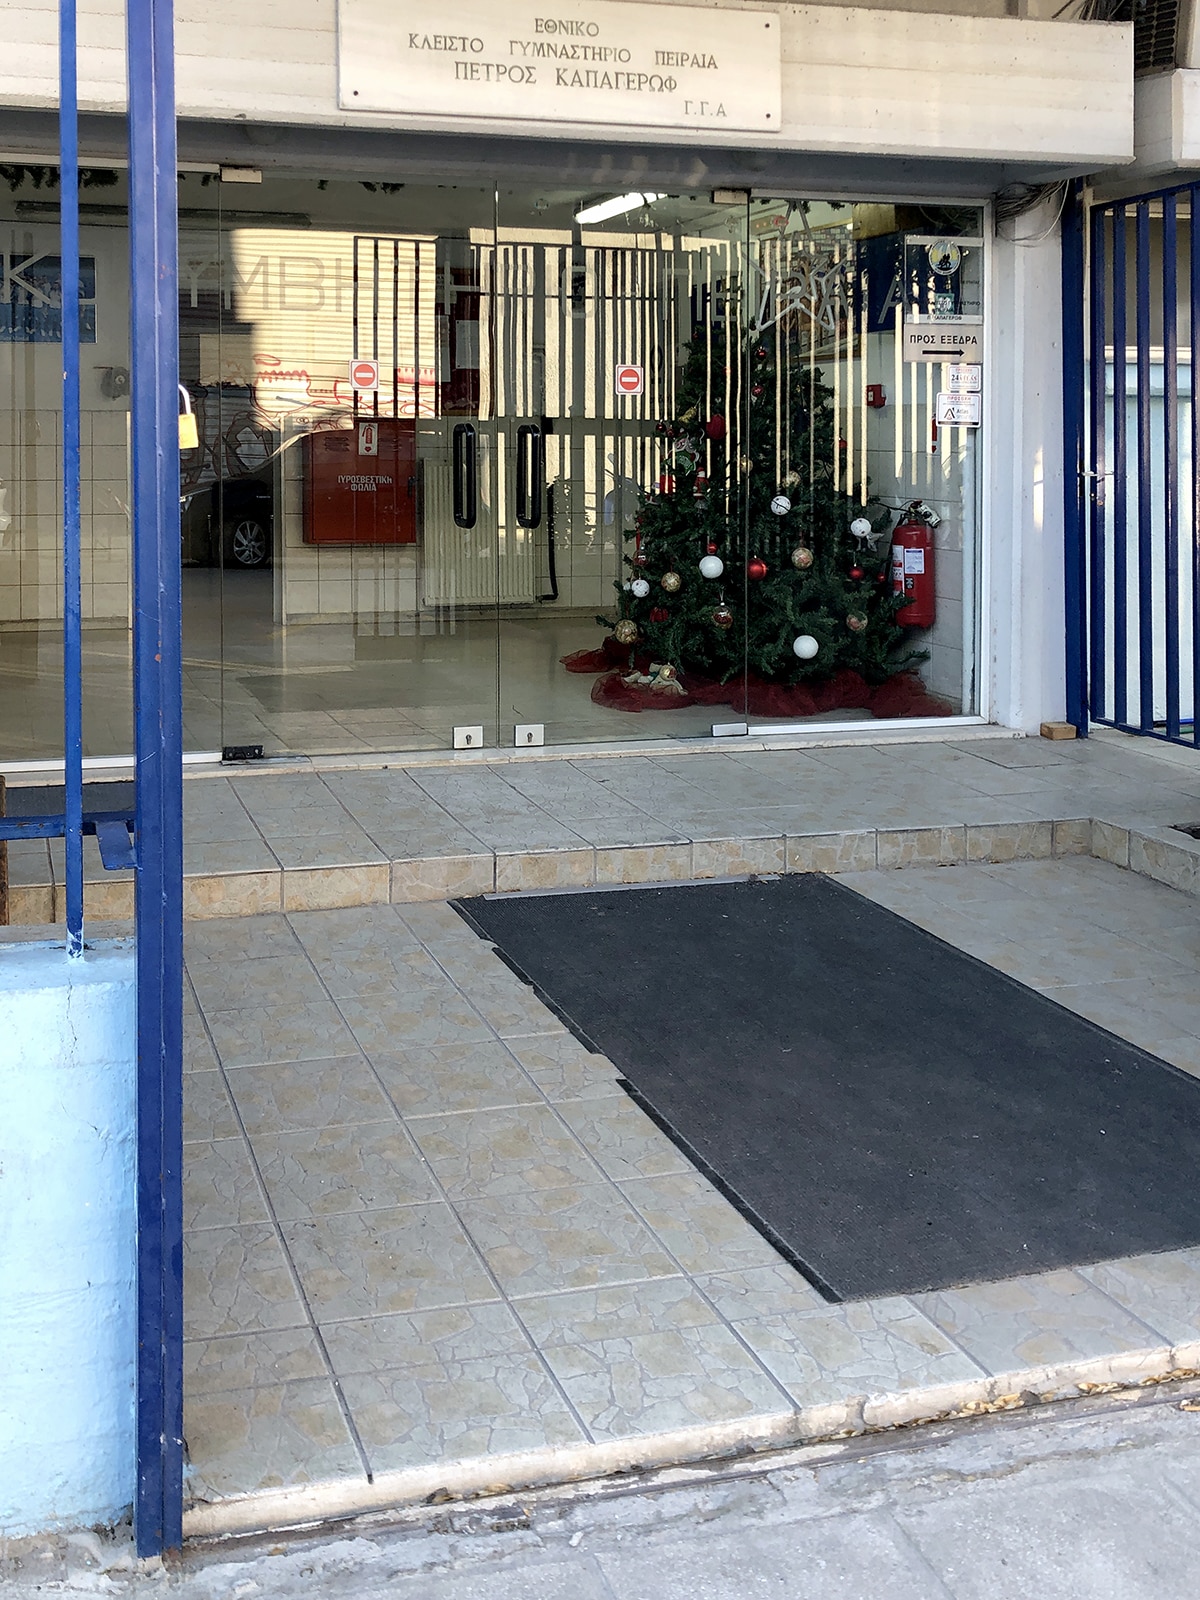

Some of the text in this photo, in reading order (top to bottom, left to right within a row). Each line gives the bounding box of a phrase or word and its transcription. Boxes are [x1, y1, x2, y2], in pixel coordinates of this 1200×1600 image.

[534, 17, 600, 38] ΕΘΝΙΚΟ
[408, 33, 718, 70] ΚΛΕΙΣΤΟ ΓΥΜΝΑΣΤΗΡΙΟ ΠΕΙΡΑΙΑ
[454, 61, 678, 93] ΠΕΤΡΟΣ ΚΑΠΑΓΕΡΩΦ
[910, 334, 978, 345] ΠΡΟΣ ΕΞΕΔΡΑ
